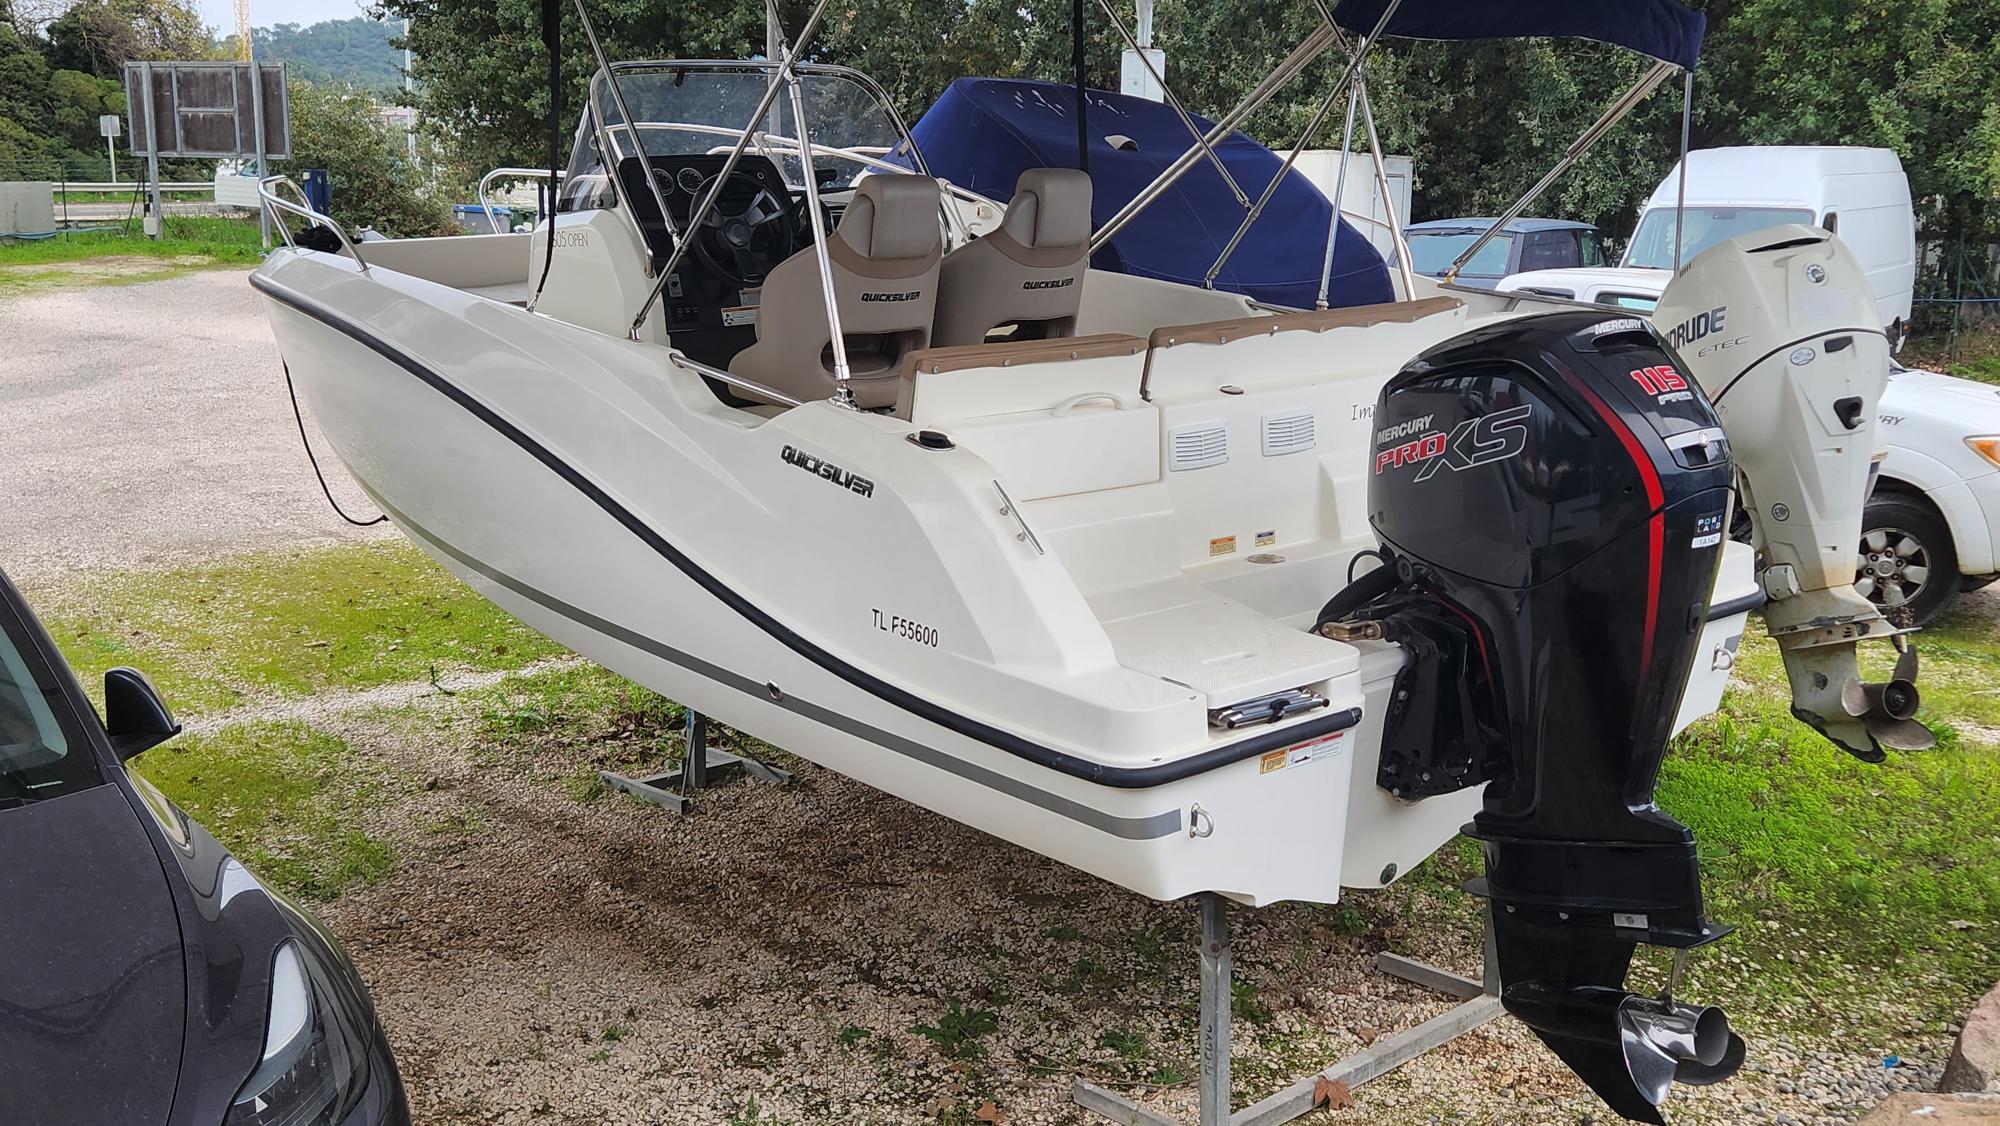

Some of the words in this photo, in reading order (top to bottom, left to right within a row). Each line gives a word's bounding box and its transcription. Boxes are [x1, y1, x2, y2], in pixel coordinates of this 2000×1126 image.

[568, 232, 589, 248] OPEN
[1022, 277, 1075, 291] QUICKSILVER
[861, 290, 921, 303] QUICKSILVER
[1594, 318, 1643, 335] MERCURY
[1698, 335, 1750, 358] E-TEC
[1630, 365, 1689, 396] 115
[1657, 391, 1694, 405] PRO
[1376, 413, 1435, 446] MERCURY
[1375, 432, 1448, 476] PRO
[1412, 403, 1533, 484] XS
[780, 443, 876, 499] QUICKSILVER
[1697, 521, 1721, 533] LAND
[1698, 514, 1722, 526] PORT
[872, 608, 888, 632] TL
[891, 615, 939, 648] F55600
